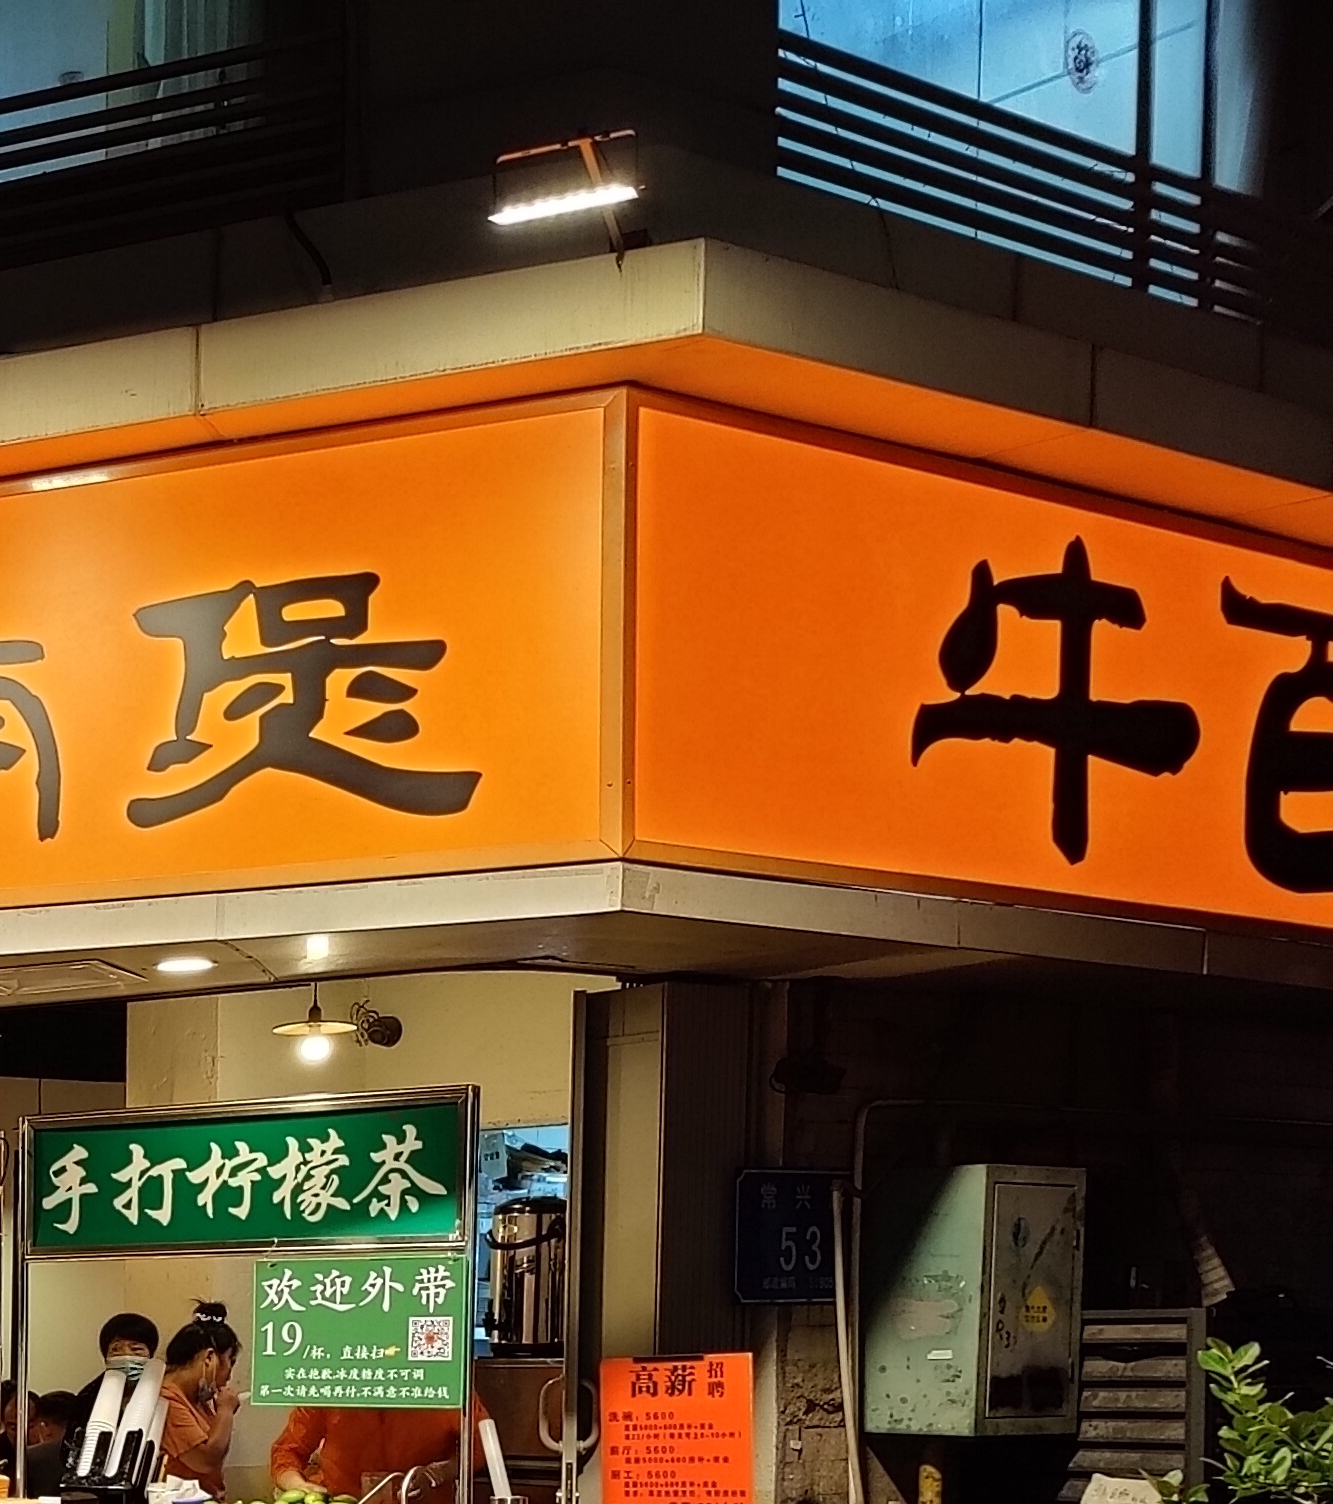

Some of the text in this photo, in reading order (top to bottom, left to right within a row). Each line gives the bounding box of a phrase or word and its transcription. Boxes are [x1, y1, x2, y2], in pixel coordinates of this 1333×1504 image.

[41, 1123, 448, 1235] 手打柠檬茶
[779, 1225, 822, 1272] 53
[259, 1264, 457, 1315] 欢迎外带
[629, 1360, 726, 1398] 高薪 招聘
